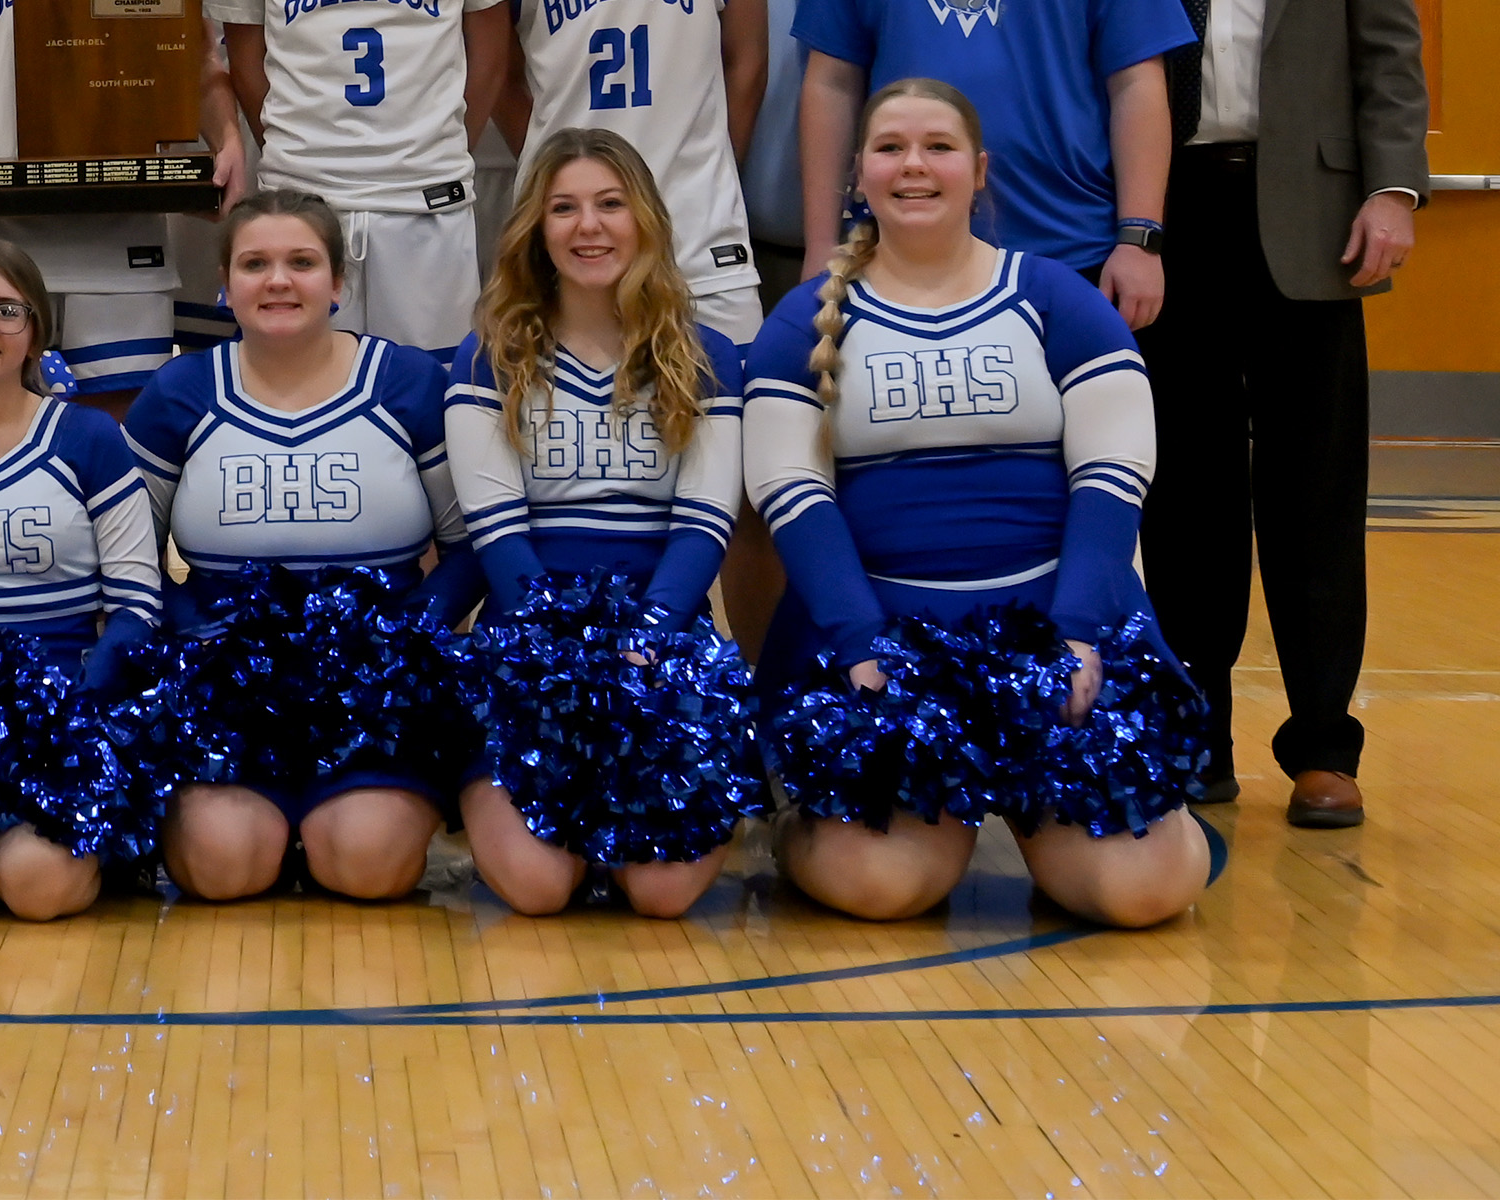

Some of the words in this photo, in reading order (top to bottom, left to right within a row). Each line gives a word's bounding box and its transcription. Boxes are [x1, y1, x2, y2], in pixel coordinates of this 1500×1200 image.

[45, 39, 105, 47] JAC-CEN-DEL
[156, 43, 185, 51] MILAN
[342, 27, 385, 107] 3
[589, 24, 652, 110] 21
[89, 80, 121, 88] SOUTH
[123, 79, 155, 87] RIPLEY
[453, 187, 460, 196] S
[865, 345, 1019, 423] BHS
[529, 408, 668, 480] BHS
[219, 452, 361, 526] BHS
